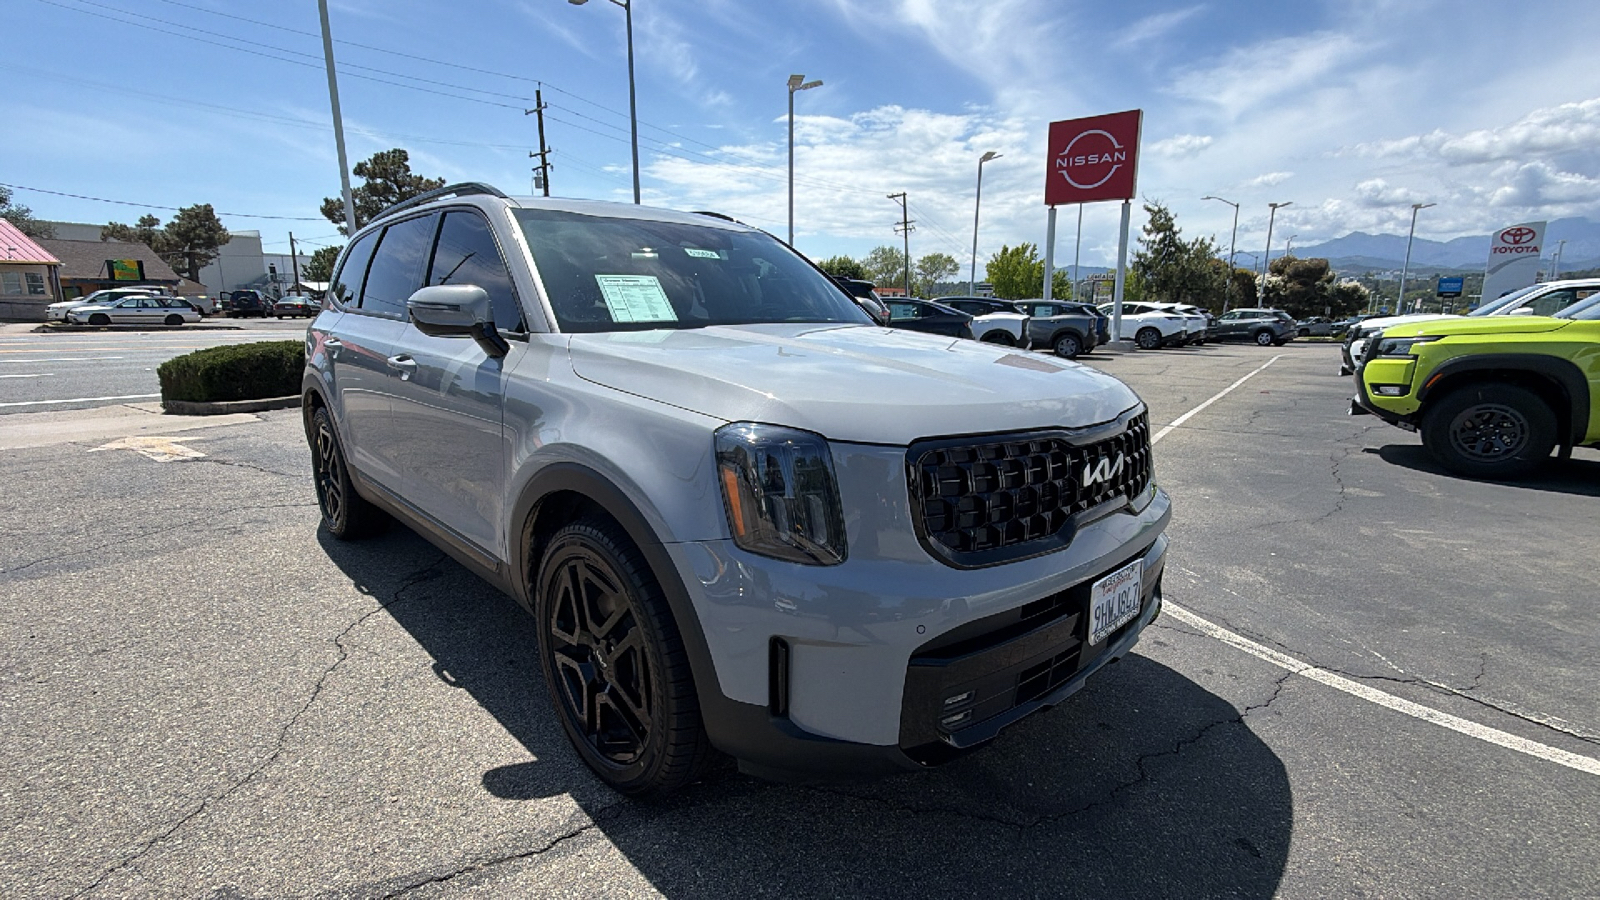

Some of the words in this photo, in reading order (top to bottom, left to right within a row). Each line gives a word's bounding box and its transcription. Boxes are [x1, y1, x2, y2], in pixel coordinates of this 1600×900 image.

[1056, 151, 1126, 168] NISSAN
[1492, 246, 1539, 254] TOYOTA
[1083, 451, 1124, 487] KIA
